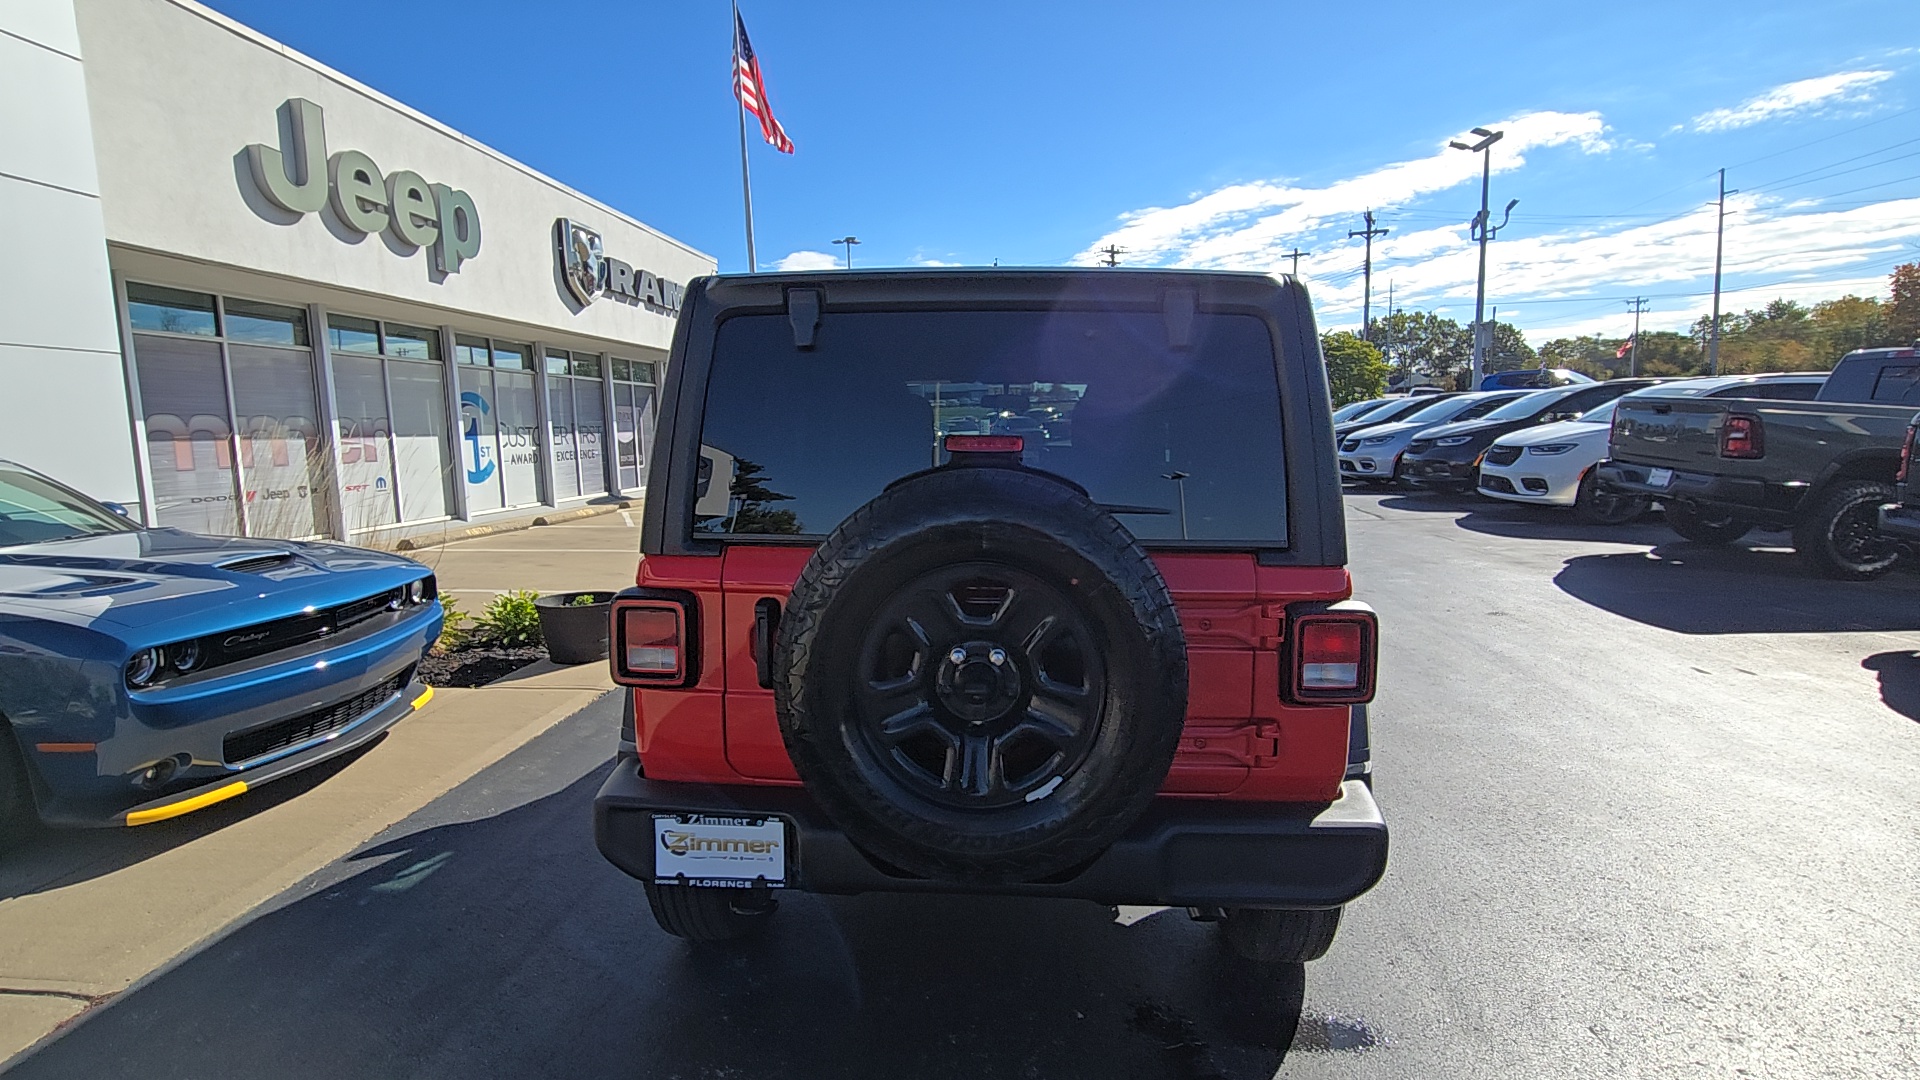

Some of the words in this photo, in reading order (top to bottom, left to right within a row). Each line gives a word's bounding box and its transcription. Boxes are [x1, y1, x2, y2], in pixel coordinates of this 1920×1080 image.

[246, 98, 481, 275] Jeep
[604, 256, 685, 312] RAM
[499, 421, 569, 448] USTOER
[510, 453, 539, 465] AWARD
[556, 449, 596, 462] EXCEENCE
[191, 494, 239, 503] DODG
[263, 488, 290, 500] Jeep
[345, 484, 370, 492] SRT
[687, 813, 750, 826] Zimmer
[667, 831, 780, 854] Zimmer
[688, 880, 753, 889] FLORENCE
